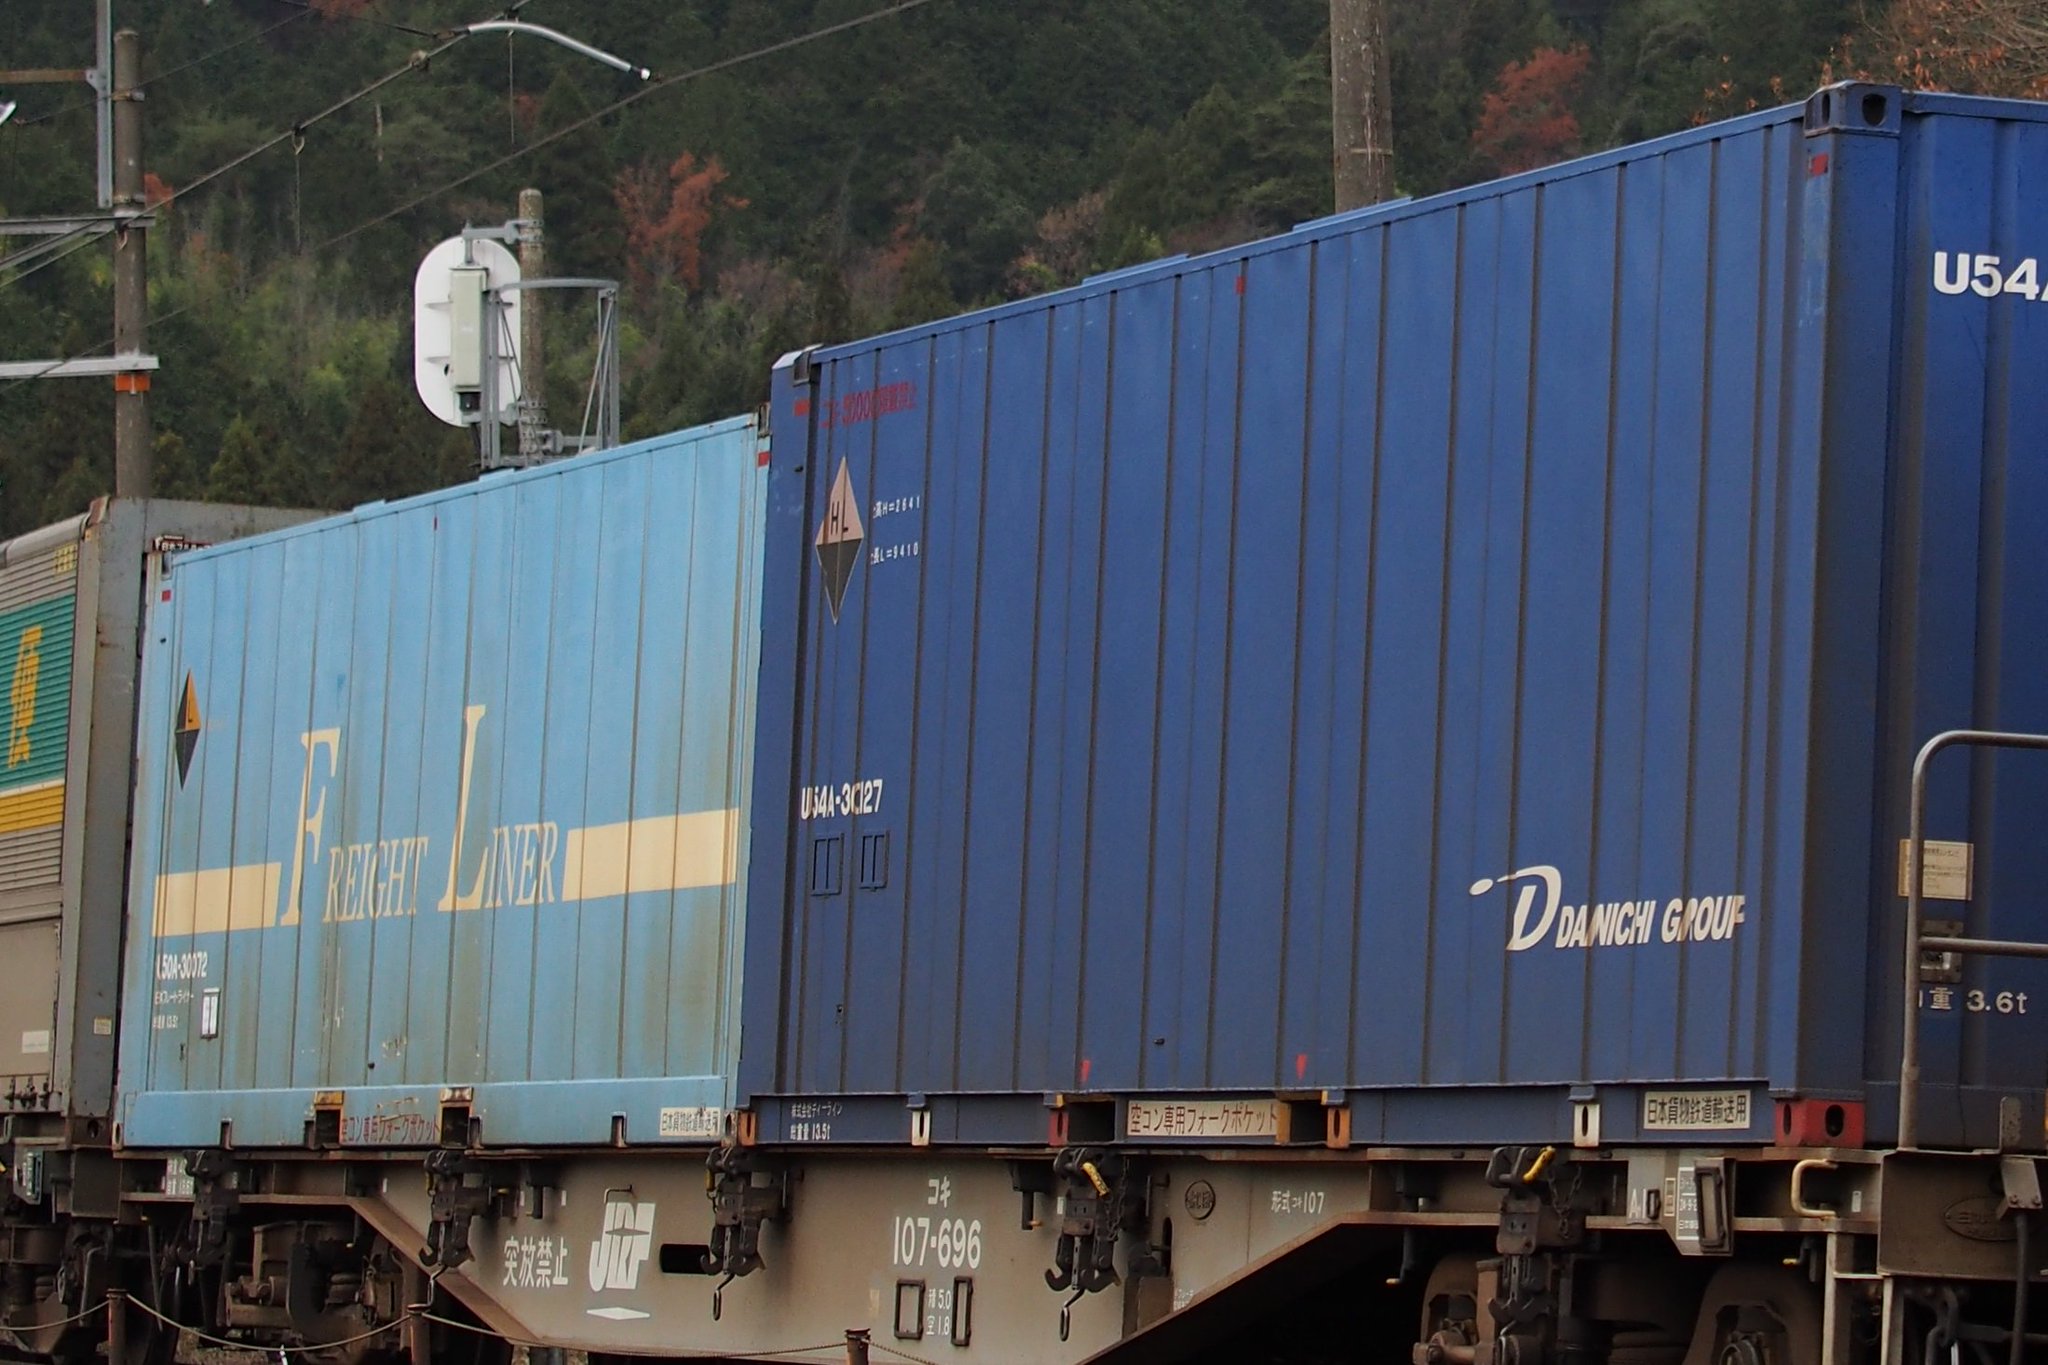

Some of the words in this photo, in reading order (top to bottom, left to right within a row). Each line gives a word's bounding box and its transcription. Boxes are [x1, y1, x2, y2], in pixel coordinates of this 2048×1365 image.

[1934, 251, 2048, 302] U54
[280, 727, 429, 926] FREIGHT
[437, 704, 559, 912] LINER
[1966, 989, 2028, 1014] 3.6t
[1130, 1103, 1277, 1135] 空コン専用フォークポケット
[1647, 1094, 1747, 1125] 日本貨物鉄道輸送用
[927, 1176, 951, 1208] コキ
[502, 1235, 569, 1288] 突放禁止
[893, 1216, 982, 1269] 107-696
